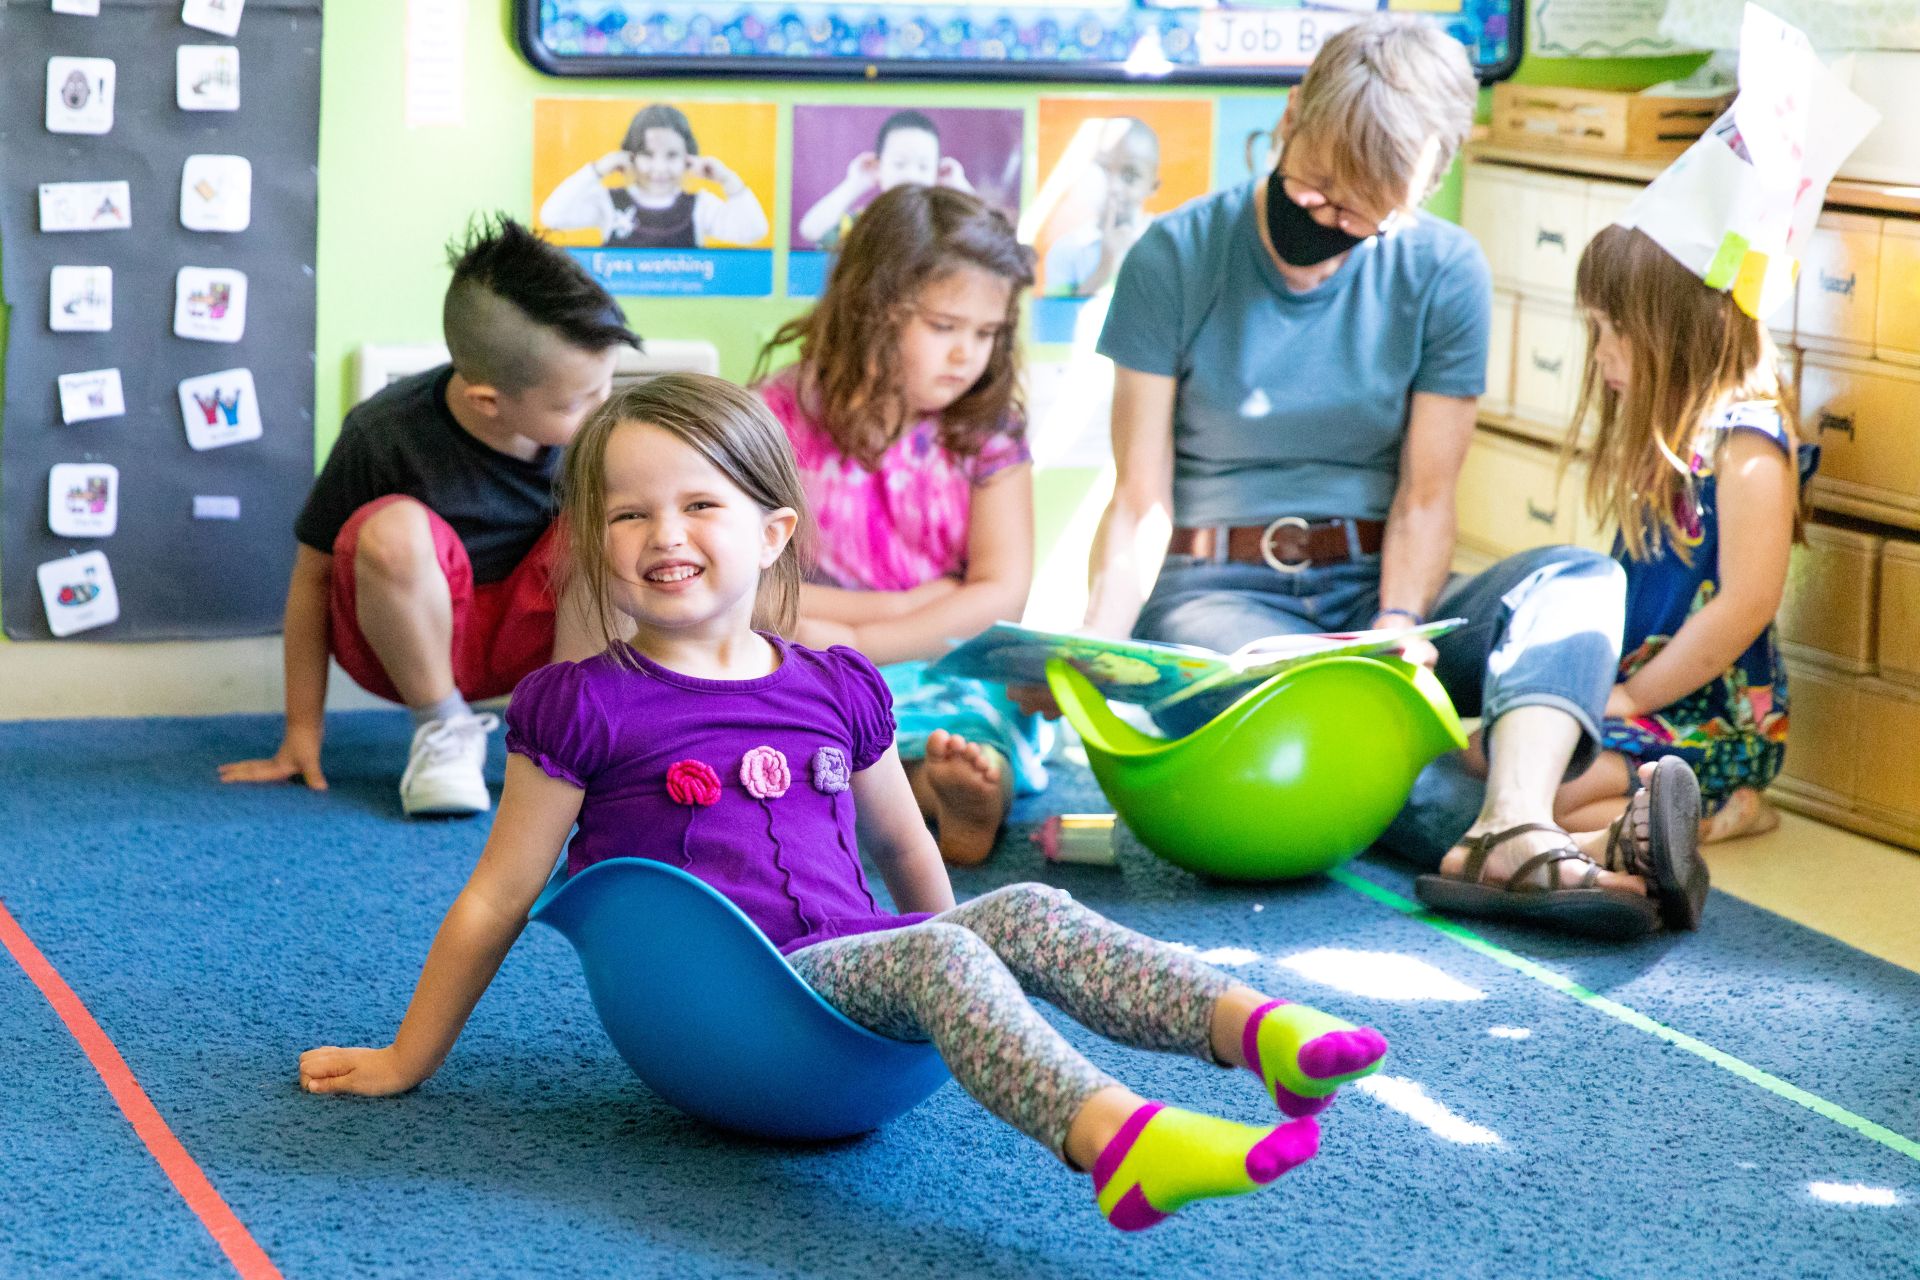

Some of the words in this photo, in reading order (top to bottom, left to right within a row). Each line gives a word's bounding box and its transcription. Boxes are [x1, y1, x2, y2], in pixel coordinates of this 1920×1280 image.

[1215, 16, 1282, 52] Job
[592, 252, 633, 277] Eyes
[638, 256, 714, 280] watching
